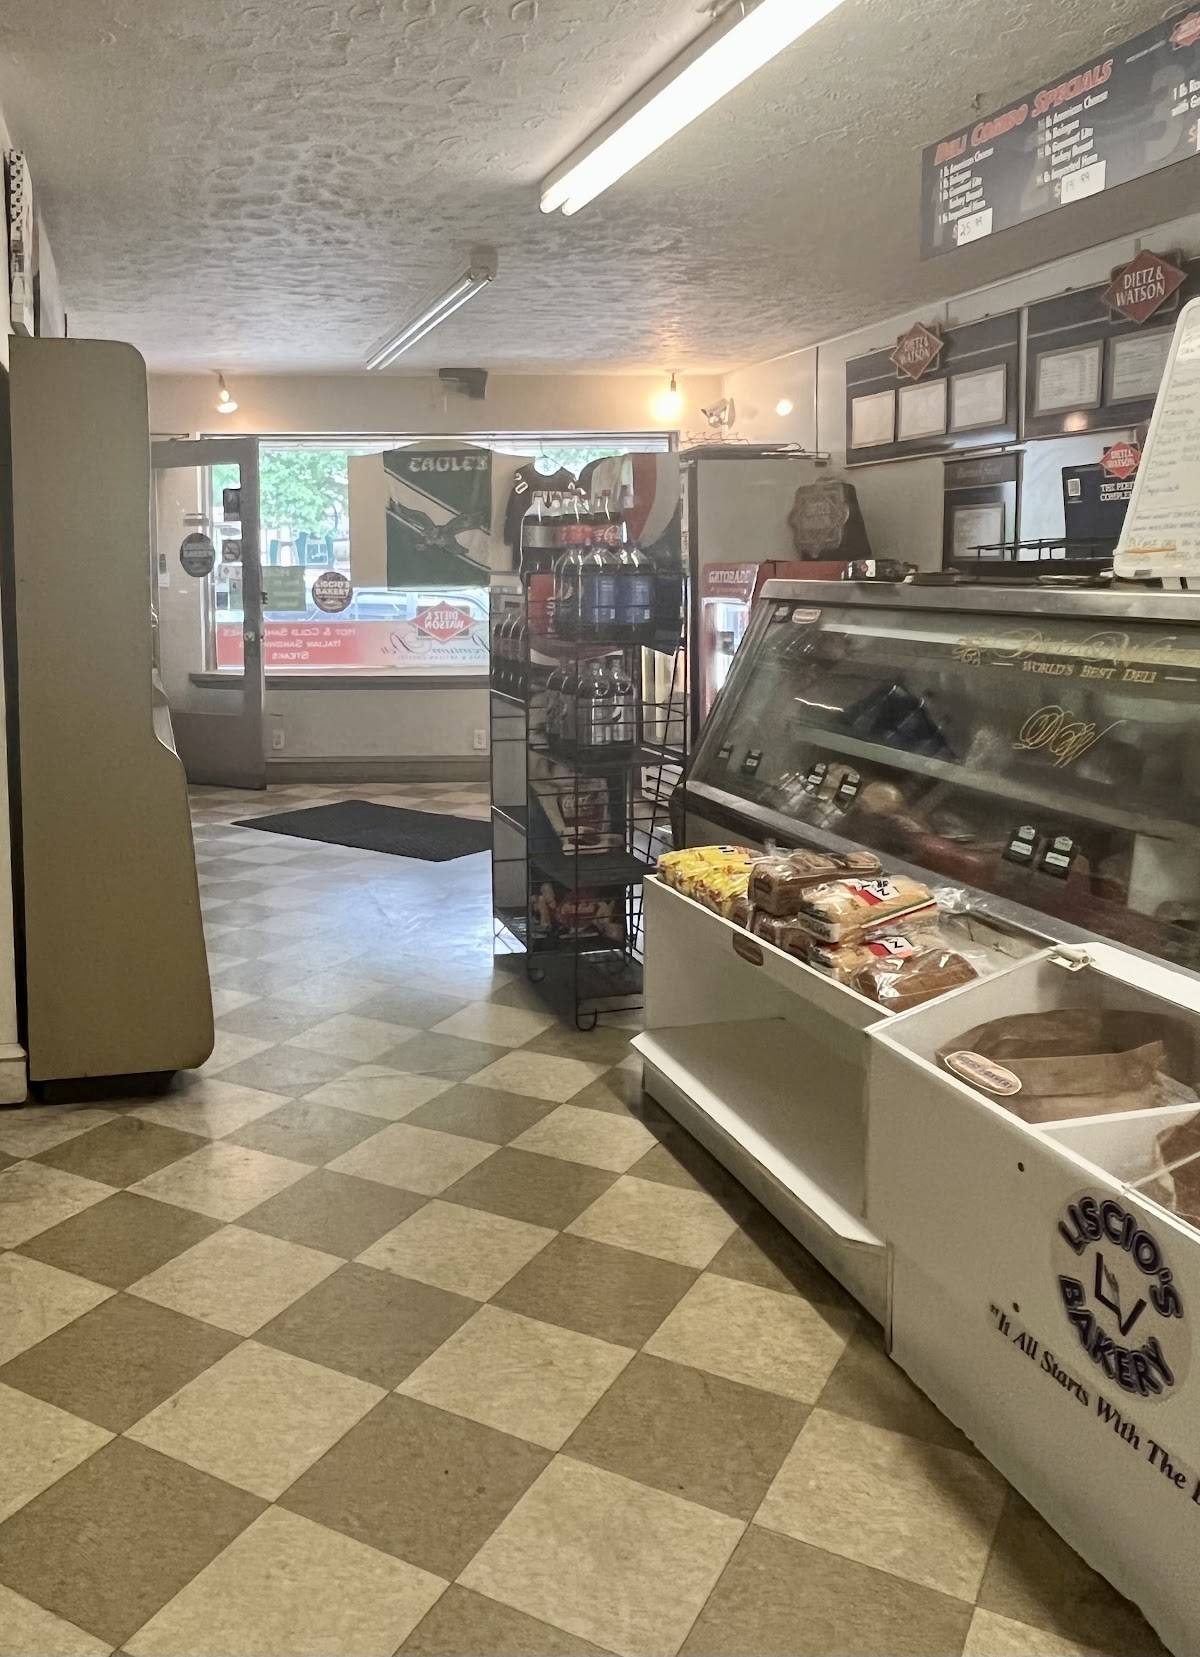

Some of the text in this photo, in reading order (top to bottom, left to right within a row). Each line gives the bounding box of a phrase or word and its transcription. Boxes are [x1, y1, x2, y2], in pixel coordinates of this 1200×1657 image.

[1031, 59, 1113, 117] SPECIALS
[1115, 282, 1165, 307] WATSON
[1124, 265, 1165, 289] DIETZ &
[1023, 660, 1158, 684] WORLD'S BEST DELI
[1059, 1196, 1184, 1319] LISCIO'S
[1058, 1275, 1175, 1397] BAKERY
[1013, 1331, 1039, 1360] All
[1040, 1351, 1089, 1406] Starts
[1096, 1396, 1140, 1450] With
[1147, 1439, 1187, 1489] The
